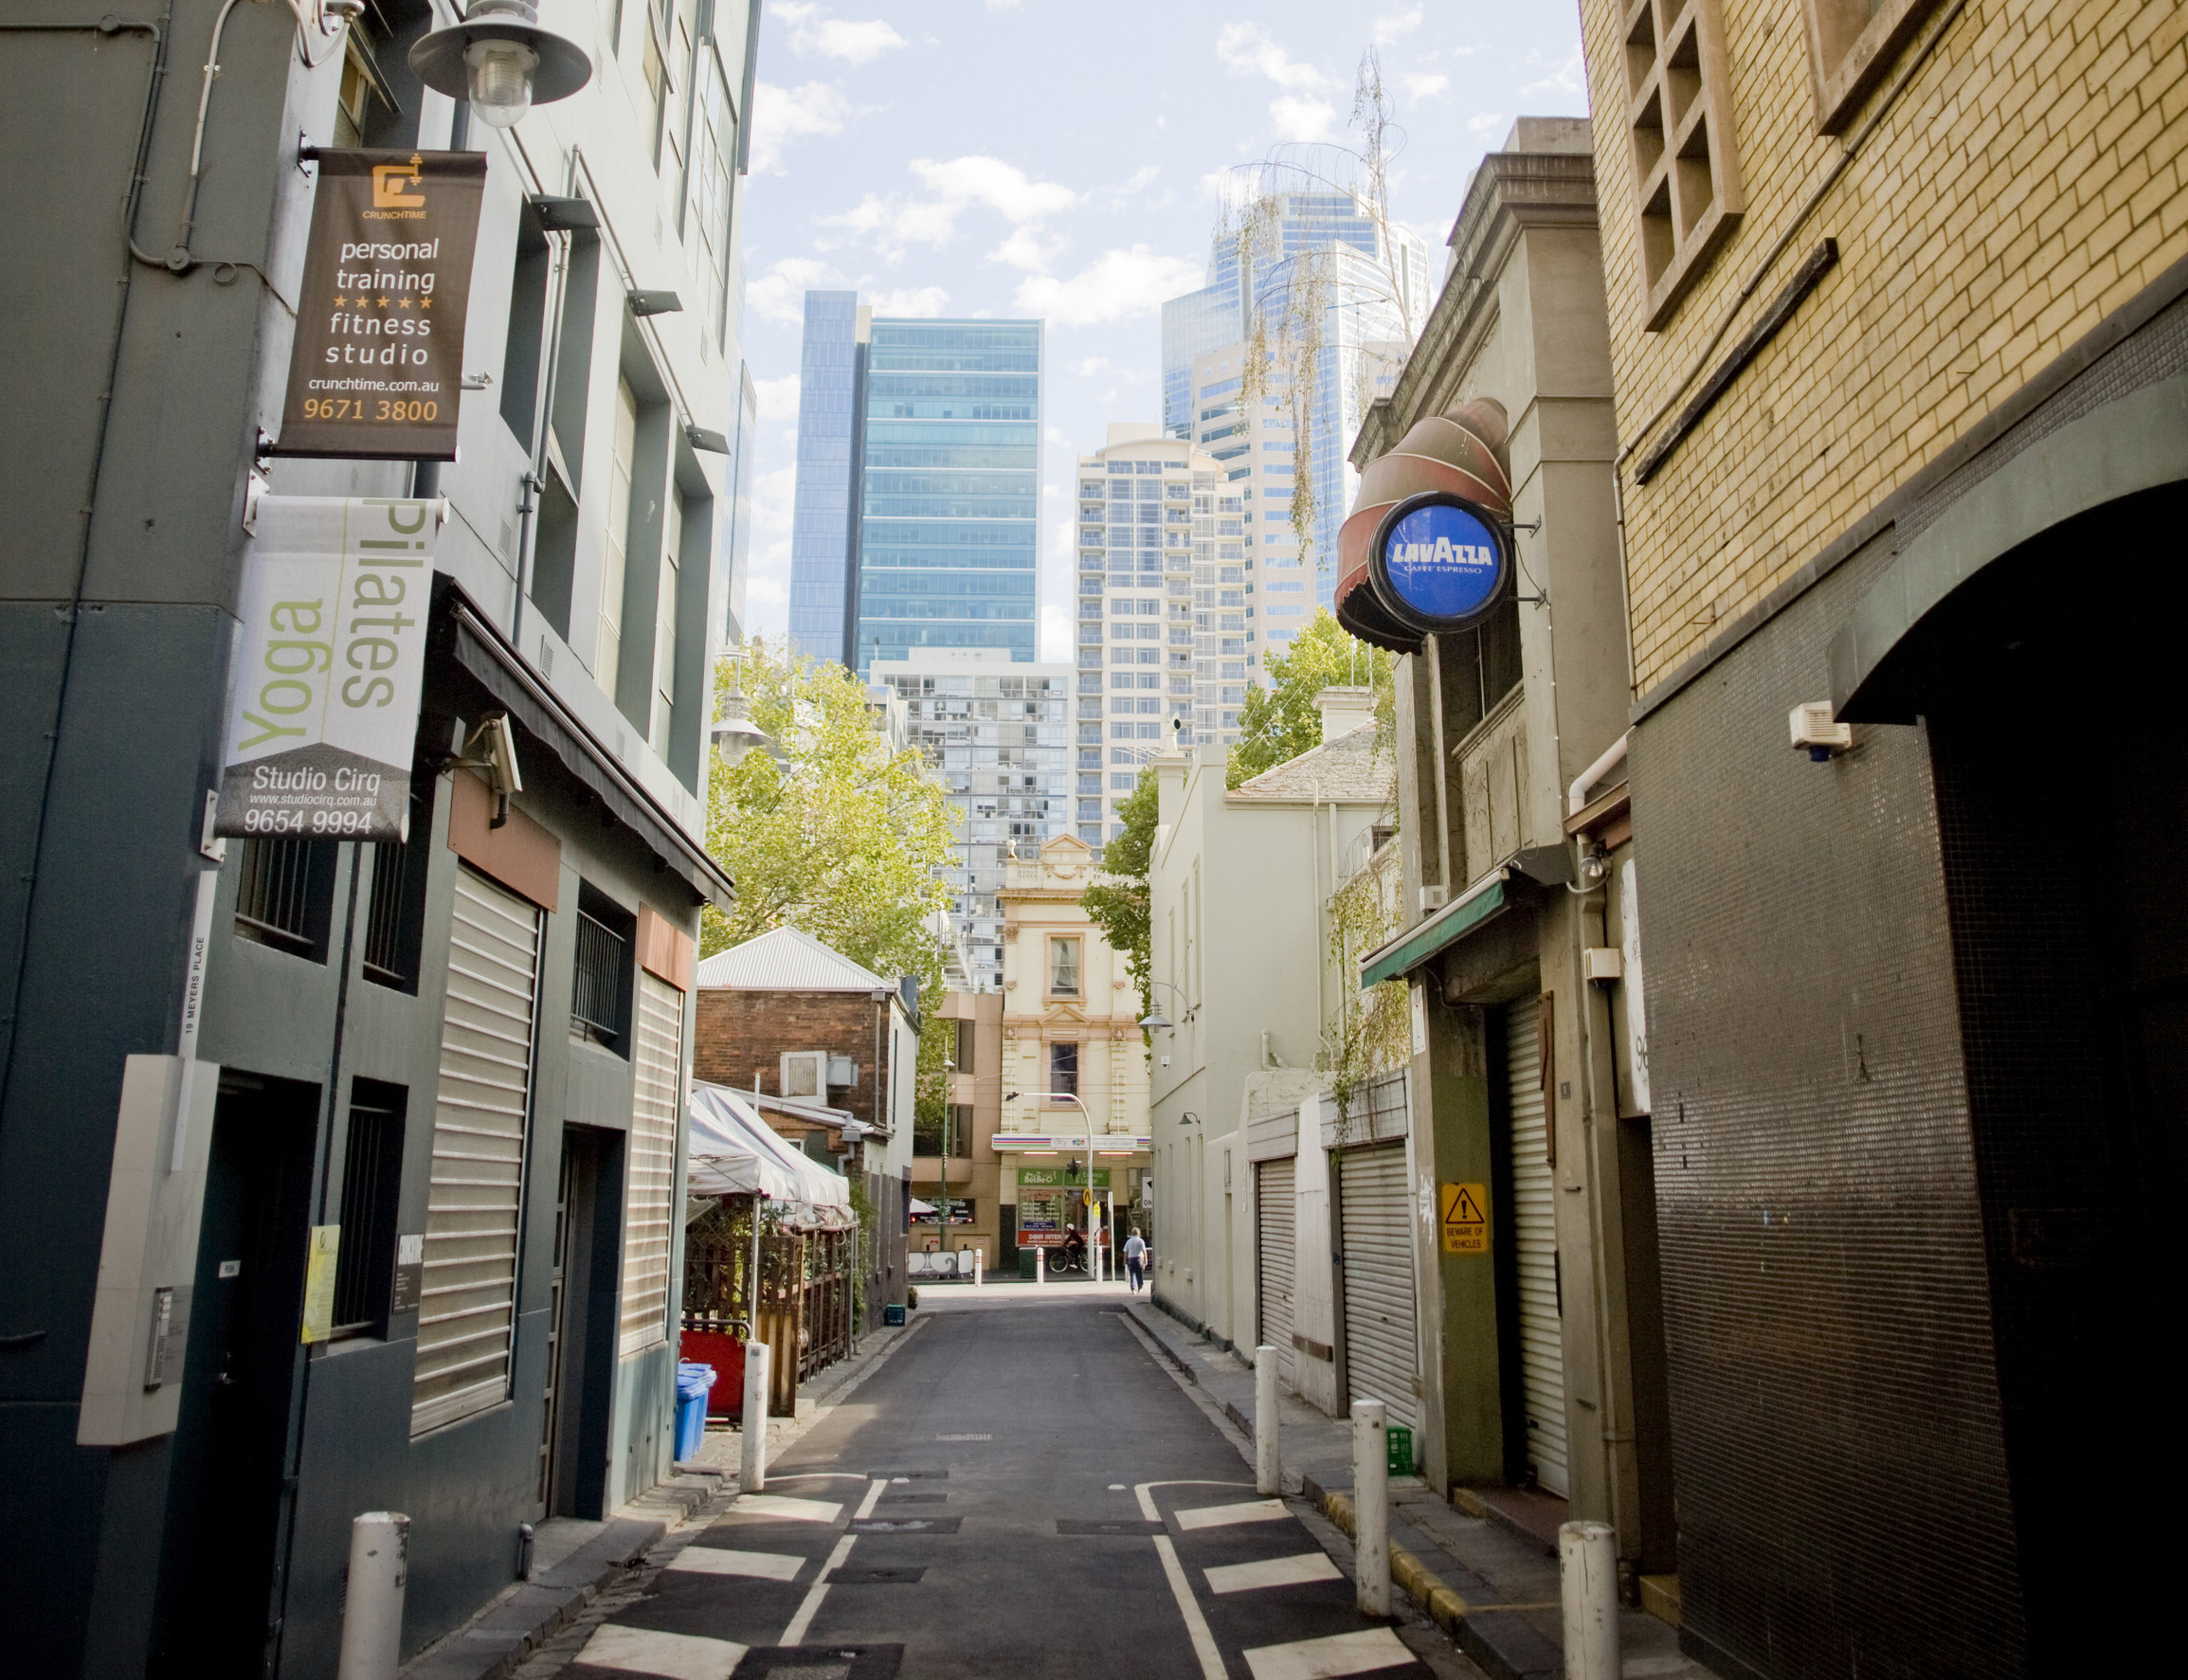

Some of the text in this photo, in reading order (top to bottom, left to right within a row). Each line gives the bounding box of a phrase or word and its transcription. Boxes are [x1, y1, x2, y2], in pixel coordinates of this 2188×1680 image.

[362, 210, 427, 220] CRUNCHTIME
[340, 238, 440, 262] personal
[336, 269, 435, 295] training
[330, 312, 431, 335] fitness
[325, 343, 428, 365] studio
[308, 377, 440, 392] crunchtime.com.au
[303, 398, 438, 421] 9671 3800
[1437, 566, 1482, 574] ESPRESSO
[341, 498, 426, 709] Pilates
[238, 598, 332, 751] Yoga
[252, 765, 381, 796] Studio Cirq
[249, 793, 377, 807] www.studiocirq.com.au
[244, 808, 372, 834] 9654 9994
[185, 937, 205, 1034] 19 MEYERS PLACE
[1446, 1226, 1484, 1237] BEWARE OF
[1451, 1239, 1482, 1249] VEHICLES
